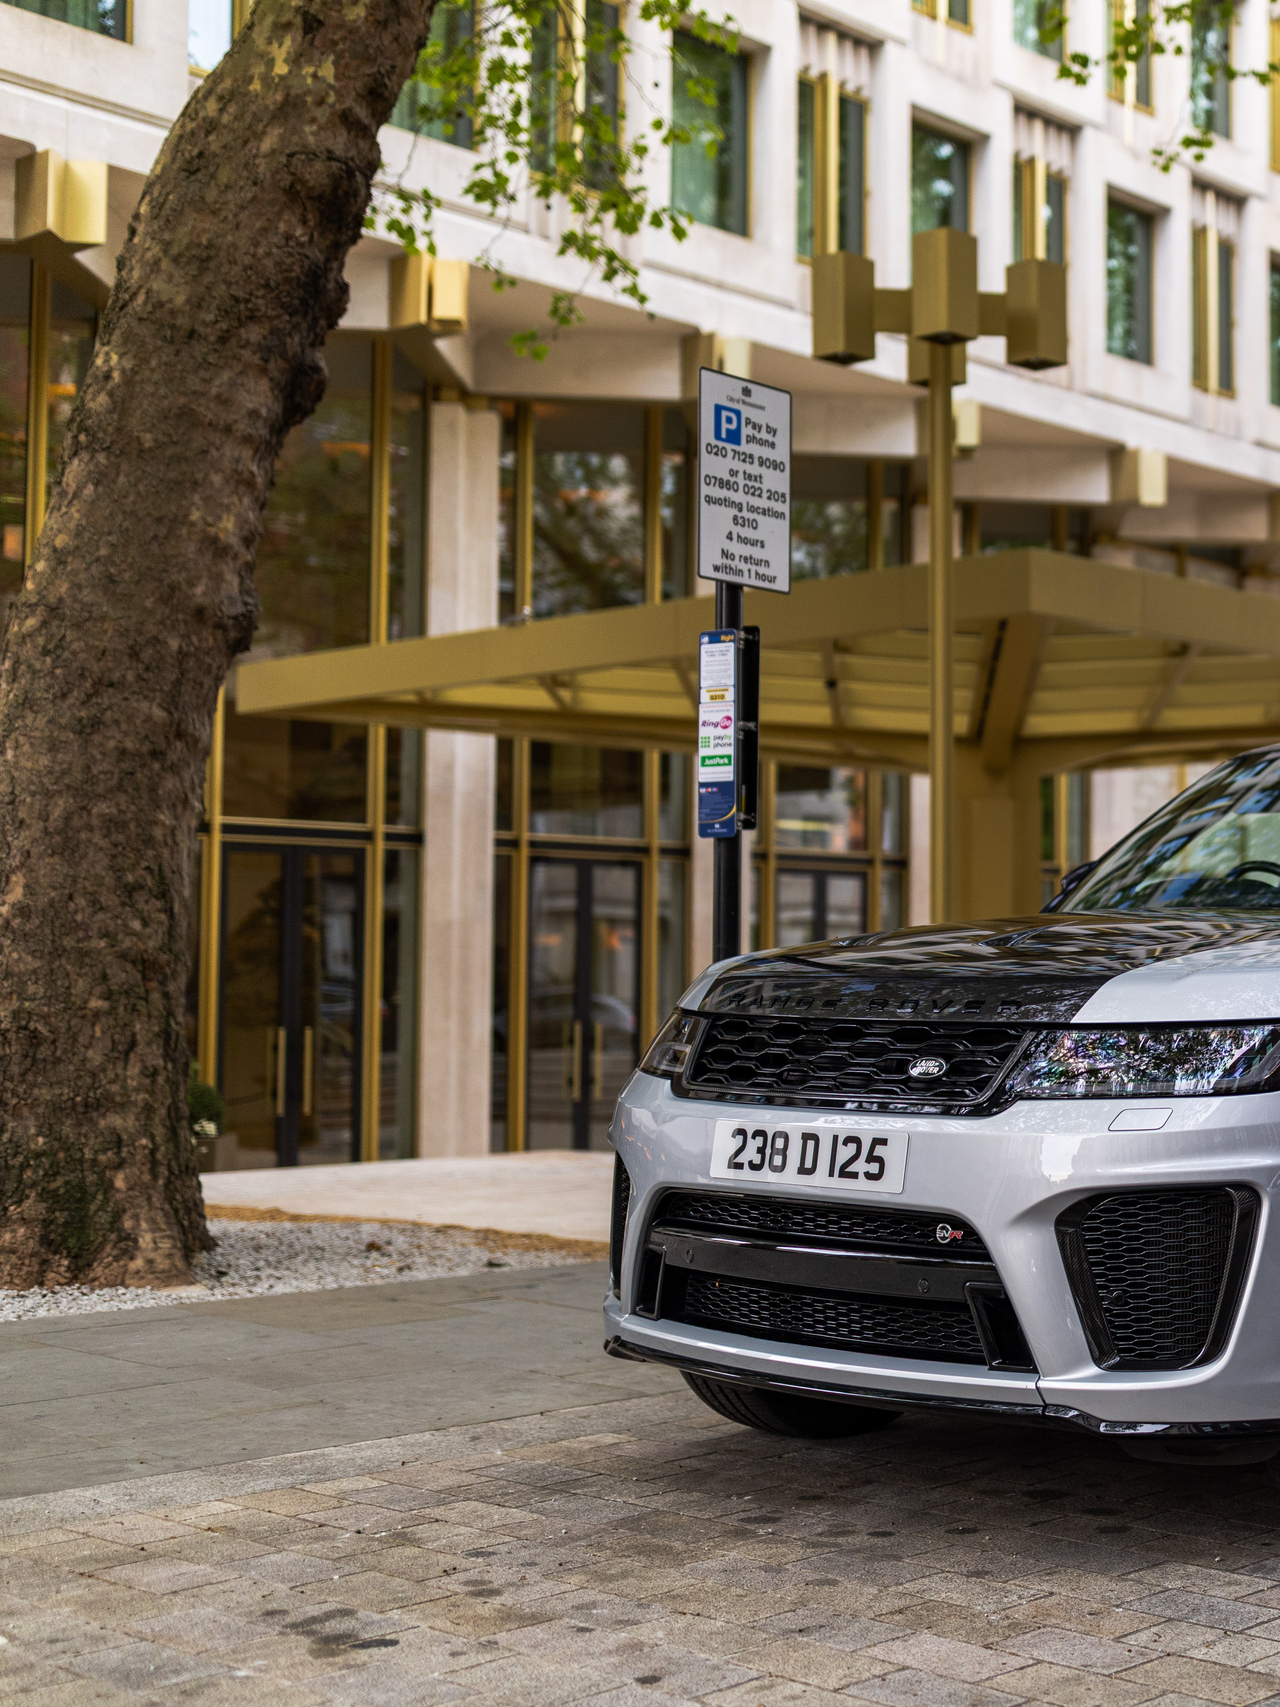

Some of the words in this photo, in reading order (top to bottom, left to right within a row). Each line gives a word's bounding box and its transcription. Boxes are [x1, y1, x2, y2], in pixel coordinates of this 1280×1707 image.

[721, 409, 737, 439] P
[744, 416, 763, 434] Pay
[765, 421, 778, 438] by
[745, 433, 776, 450] phone
[705, 442, 728, 458] 020
[730, 448, 755, 465] 7125
[757, 455, 786, 473] 9090
[728, 467, 740, 478] or
[742, 469, 763, 484] text
[703, 474, 740, 493] 07860
[742, 483, 763, 499] 022
[766, 488, 787, 504] 205
[704, 493, 743, 513] quoting
[746, 501, 786, 521] location
[732, 514, 758, 530] 6310
[726, 530, 733, 542] 4
[736, 532, 765, 549] hours
[721, 548, 736, 562] No
[738, 554, 770, 569] return
[712, 562, 744, 578] within
[747, 568, 752, 579] 1
[754, 569, 777, 584] hour
[704, 757, 729, 765] JustPark
[727, 993, 842, 1011] RANGE
[865, 998, 1026, 1015] ROVER
[727, 1127, 790, 1173] 238
[797, 1132, 820, 1176] D
[828, 1134, 889, 1181] 125
